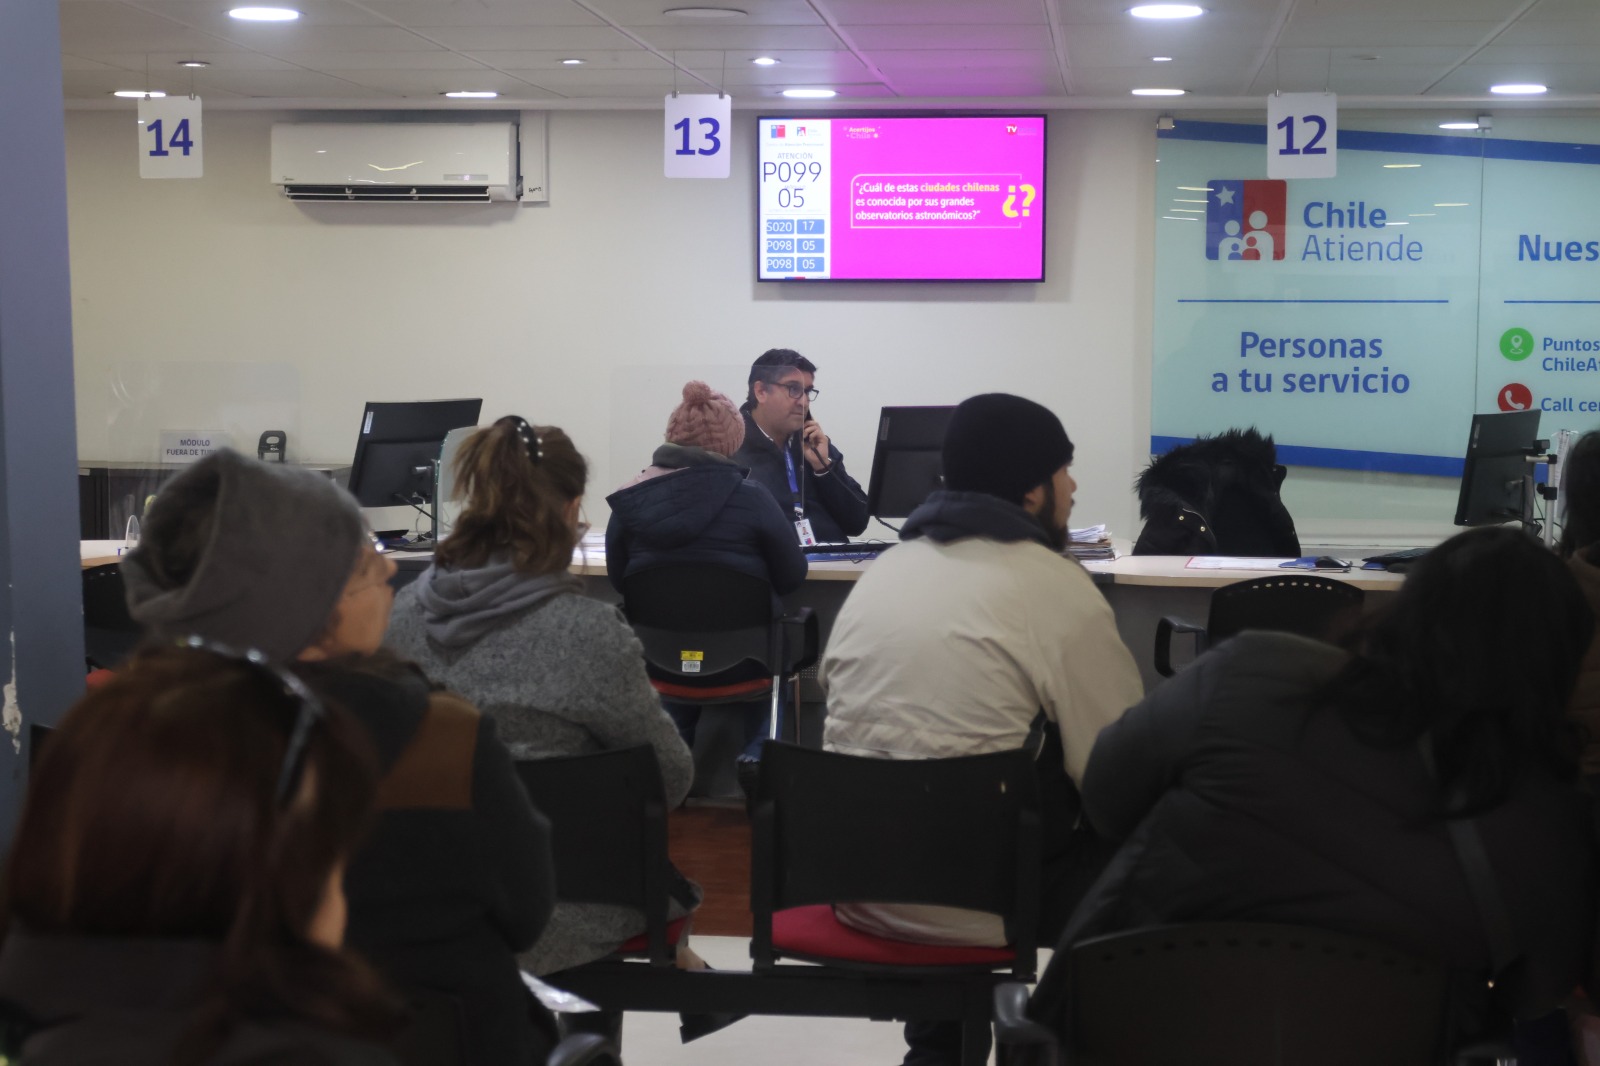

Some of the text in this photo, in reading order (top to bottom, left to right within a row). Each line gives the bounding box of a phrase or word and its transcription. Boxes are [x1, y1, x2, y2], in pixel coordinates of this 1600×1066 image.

[147, 118, 193, 156] 14
[674, 117, 721, 156] 13
[1276, 115, 1328, 155] 12
[777, 151, 813, 160] ATENCIÓN
[763, 161, 822, 183] P099
[884, 182, 896, 193] de
[897, 183, 919, 193] estas
[920, 182, 960, 192] ciudades
[962, 182, 1000, 192] chilenas
[778, 188, 805, 208] 05
[855, 196, 975, 209] es conocida por sus grandes
[855, 210, 914, 220] observatorios
[1303, 201, 1387, 229] Chile
[766, 220, 815, 232] S020 17
[766, 240, 816, 251] P098 05
[1301, 234, 1424, 262] Atiende
[1518, 234, 1600, 261] Nues
[766, 259, 816, 269] P098 05
[1240, 331, 1383, 359] Personas
[1543, 337, 1600, 352] Puntos
[1542, 357, 1600, 372] ChileA
[1211, 366, 1410, 394] a tu servicio
[1541, 398, 1600, 412] Call ce
[179, 438, 211, 447] MÓDULO
[166, 448, 188, 456] FUERA
[189, 448, 199, 456] DE
